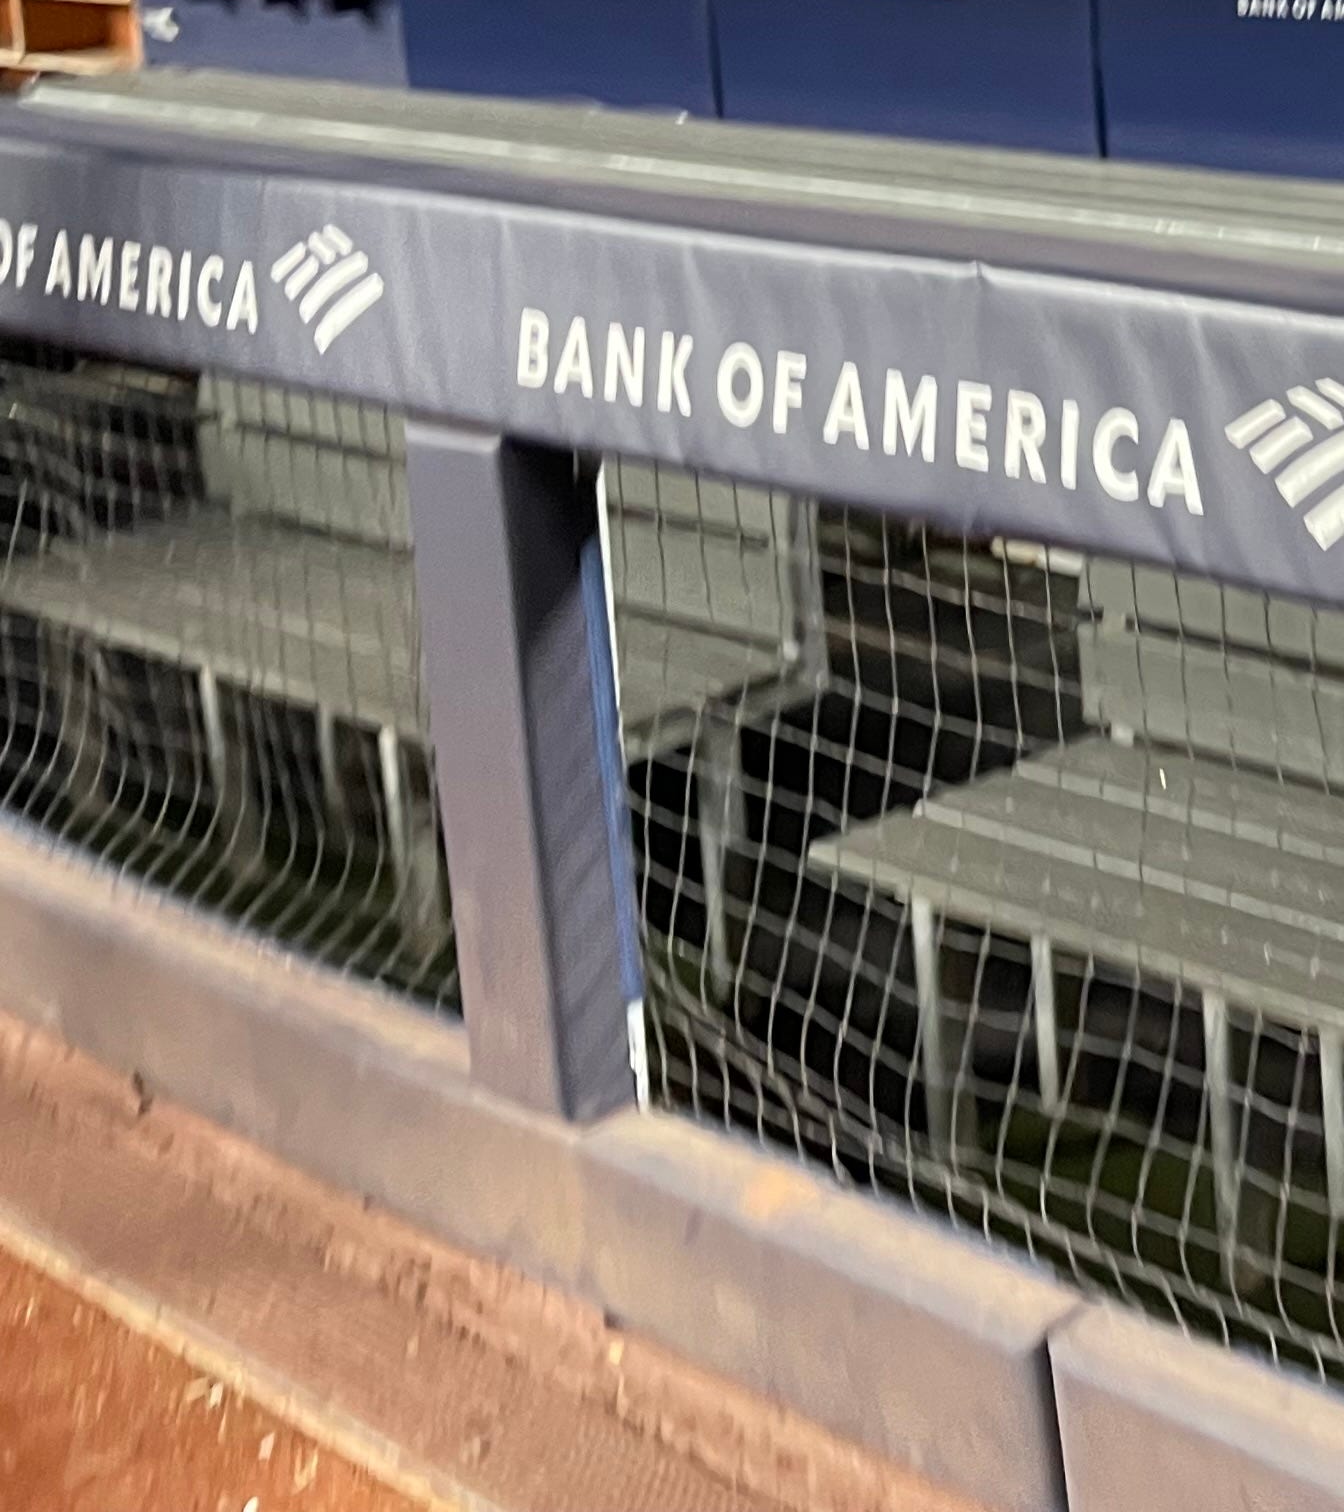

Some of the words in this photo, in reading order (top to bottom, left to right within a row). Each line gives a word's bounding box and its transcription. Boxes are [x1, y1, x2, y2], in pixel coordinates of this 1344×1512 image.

[45, 229, 258, 335] AMERICA
[516, 307, 693, 417] BANK
[716, 342, 806, 434] OF
[822, 361, 1205, 516] AMERICA
